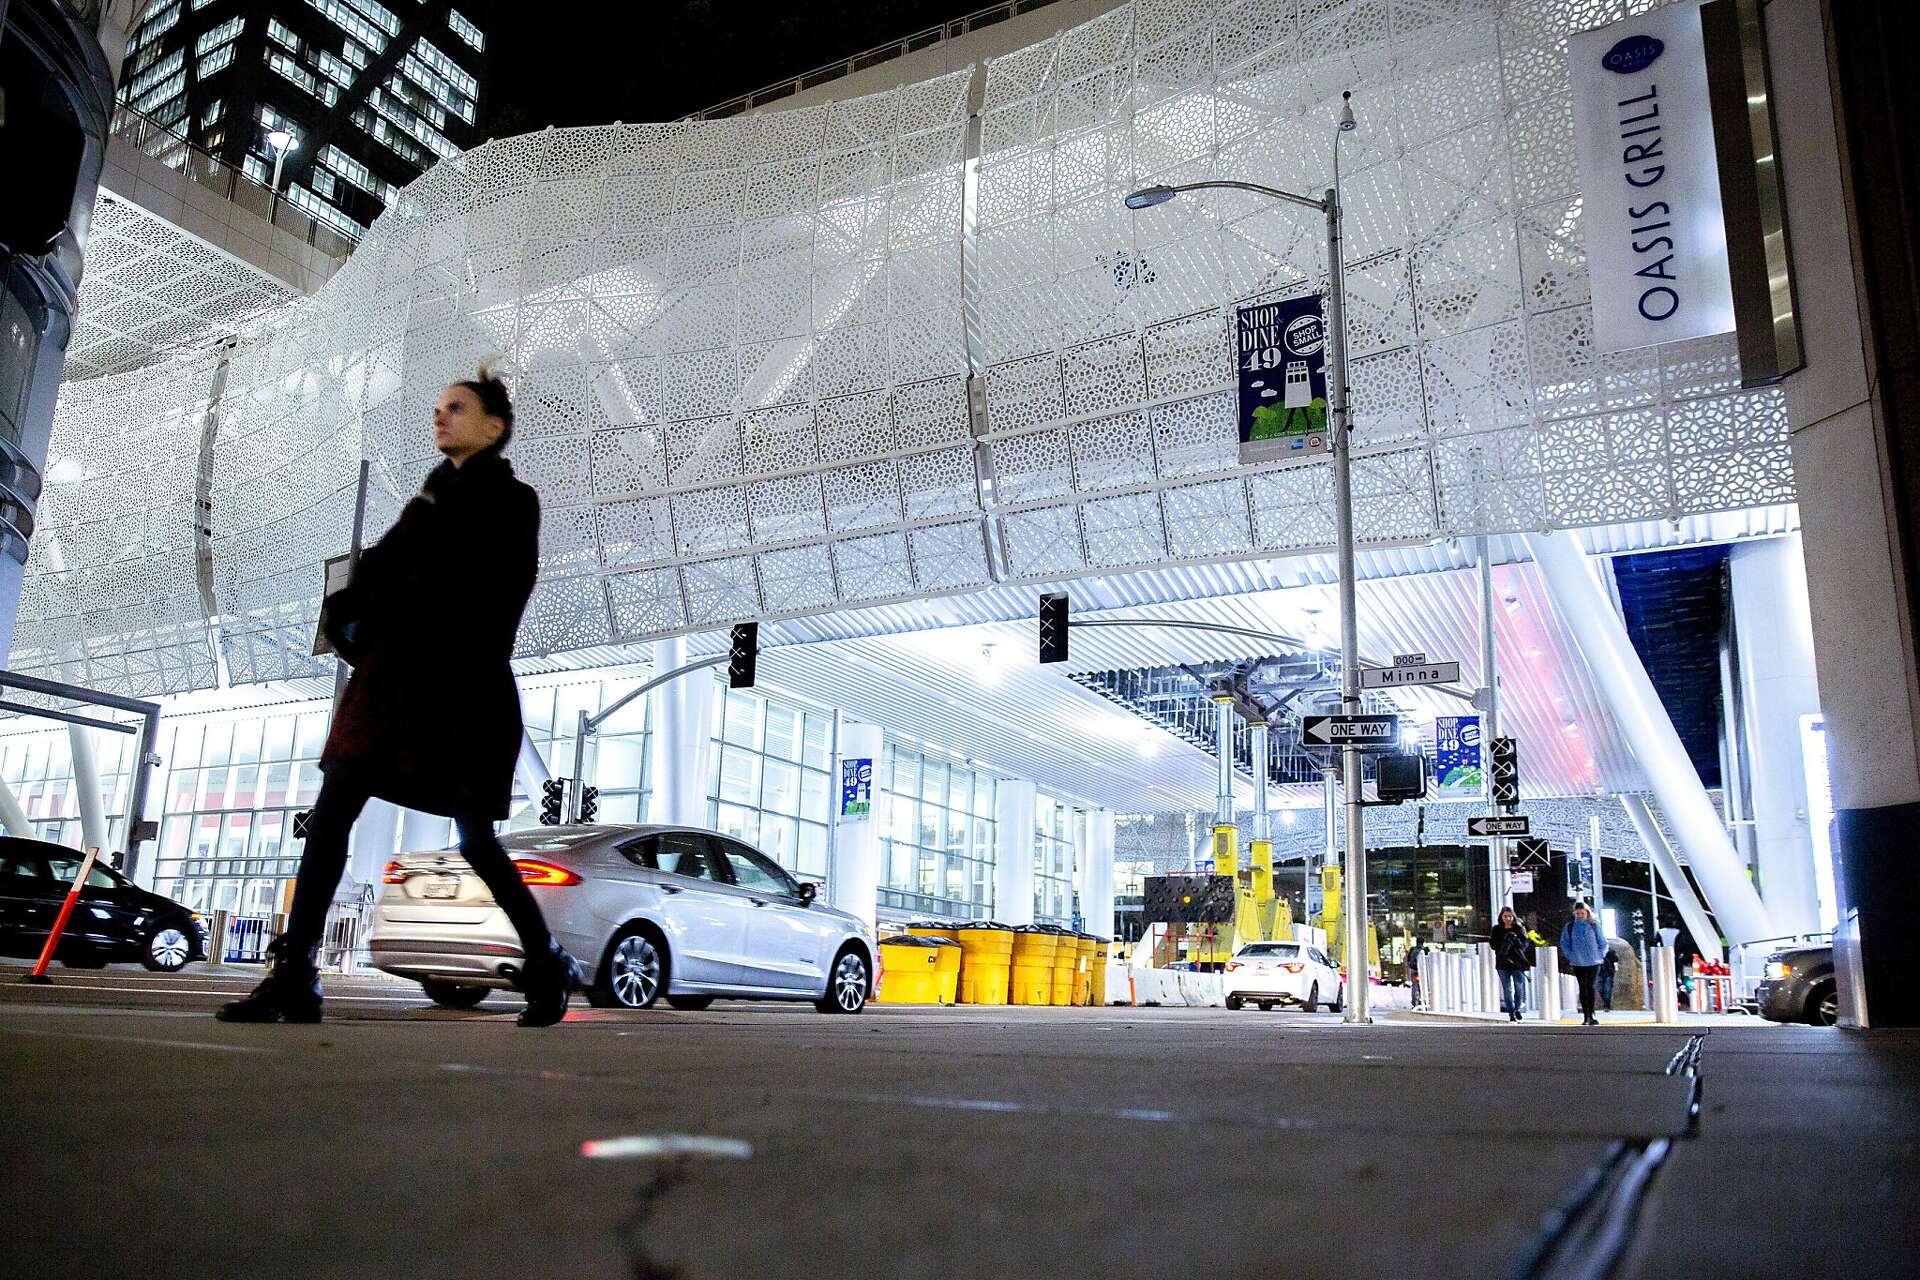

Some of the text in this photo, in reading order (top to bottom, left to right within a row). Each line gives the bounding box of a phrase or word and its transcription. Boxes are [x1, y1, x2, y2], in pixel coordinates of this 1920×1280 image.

[1610, 45, 1656, 65] OASIS
[1617, 84, 1666, 188] GRILL
[1628, 201, 1680, 322] OASIS
[1241, 306, 1279, 331] SHOP
[1241, 325, 1280, 352] DINE
[1293, 324, 1317, 340] SHOP
[1293, 331, 1323, 347] SMALL
[1241, 347, 1282, 372] 49
[1395, 655, 1415, 665] 000
[1382, 670, 1439, 683] Minna
[1330, 723, 1387, 736] ONE WAY
[1437, 717, 1459, 729] SHOP
[1438, 728, 1459, 740] DINE
[1438, 739, 1460, 751] 49
[1486, 822, 1523, 831] ONE WAY
